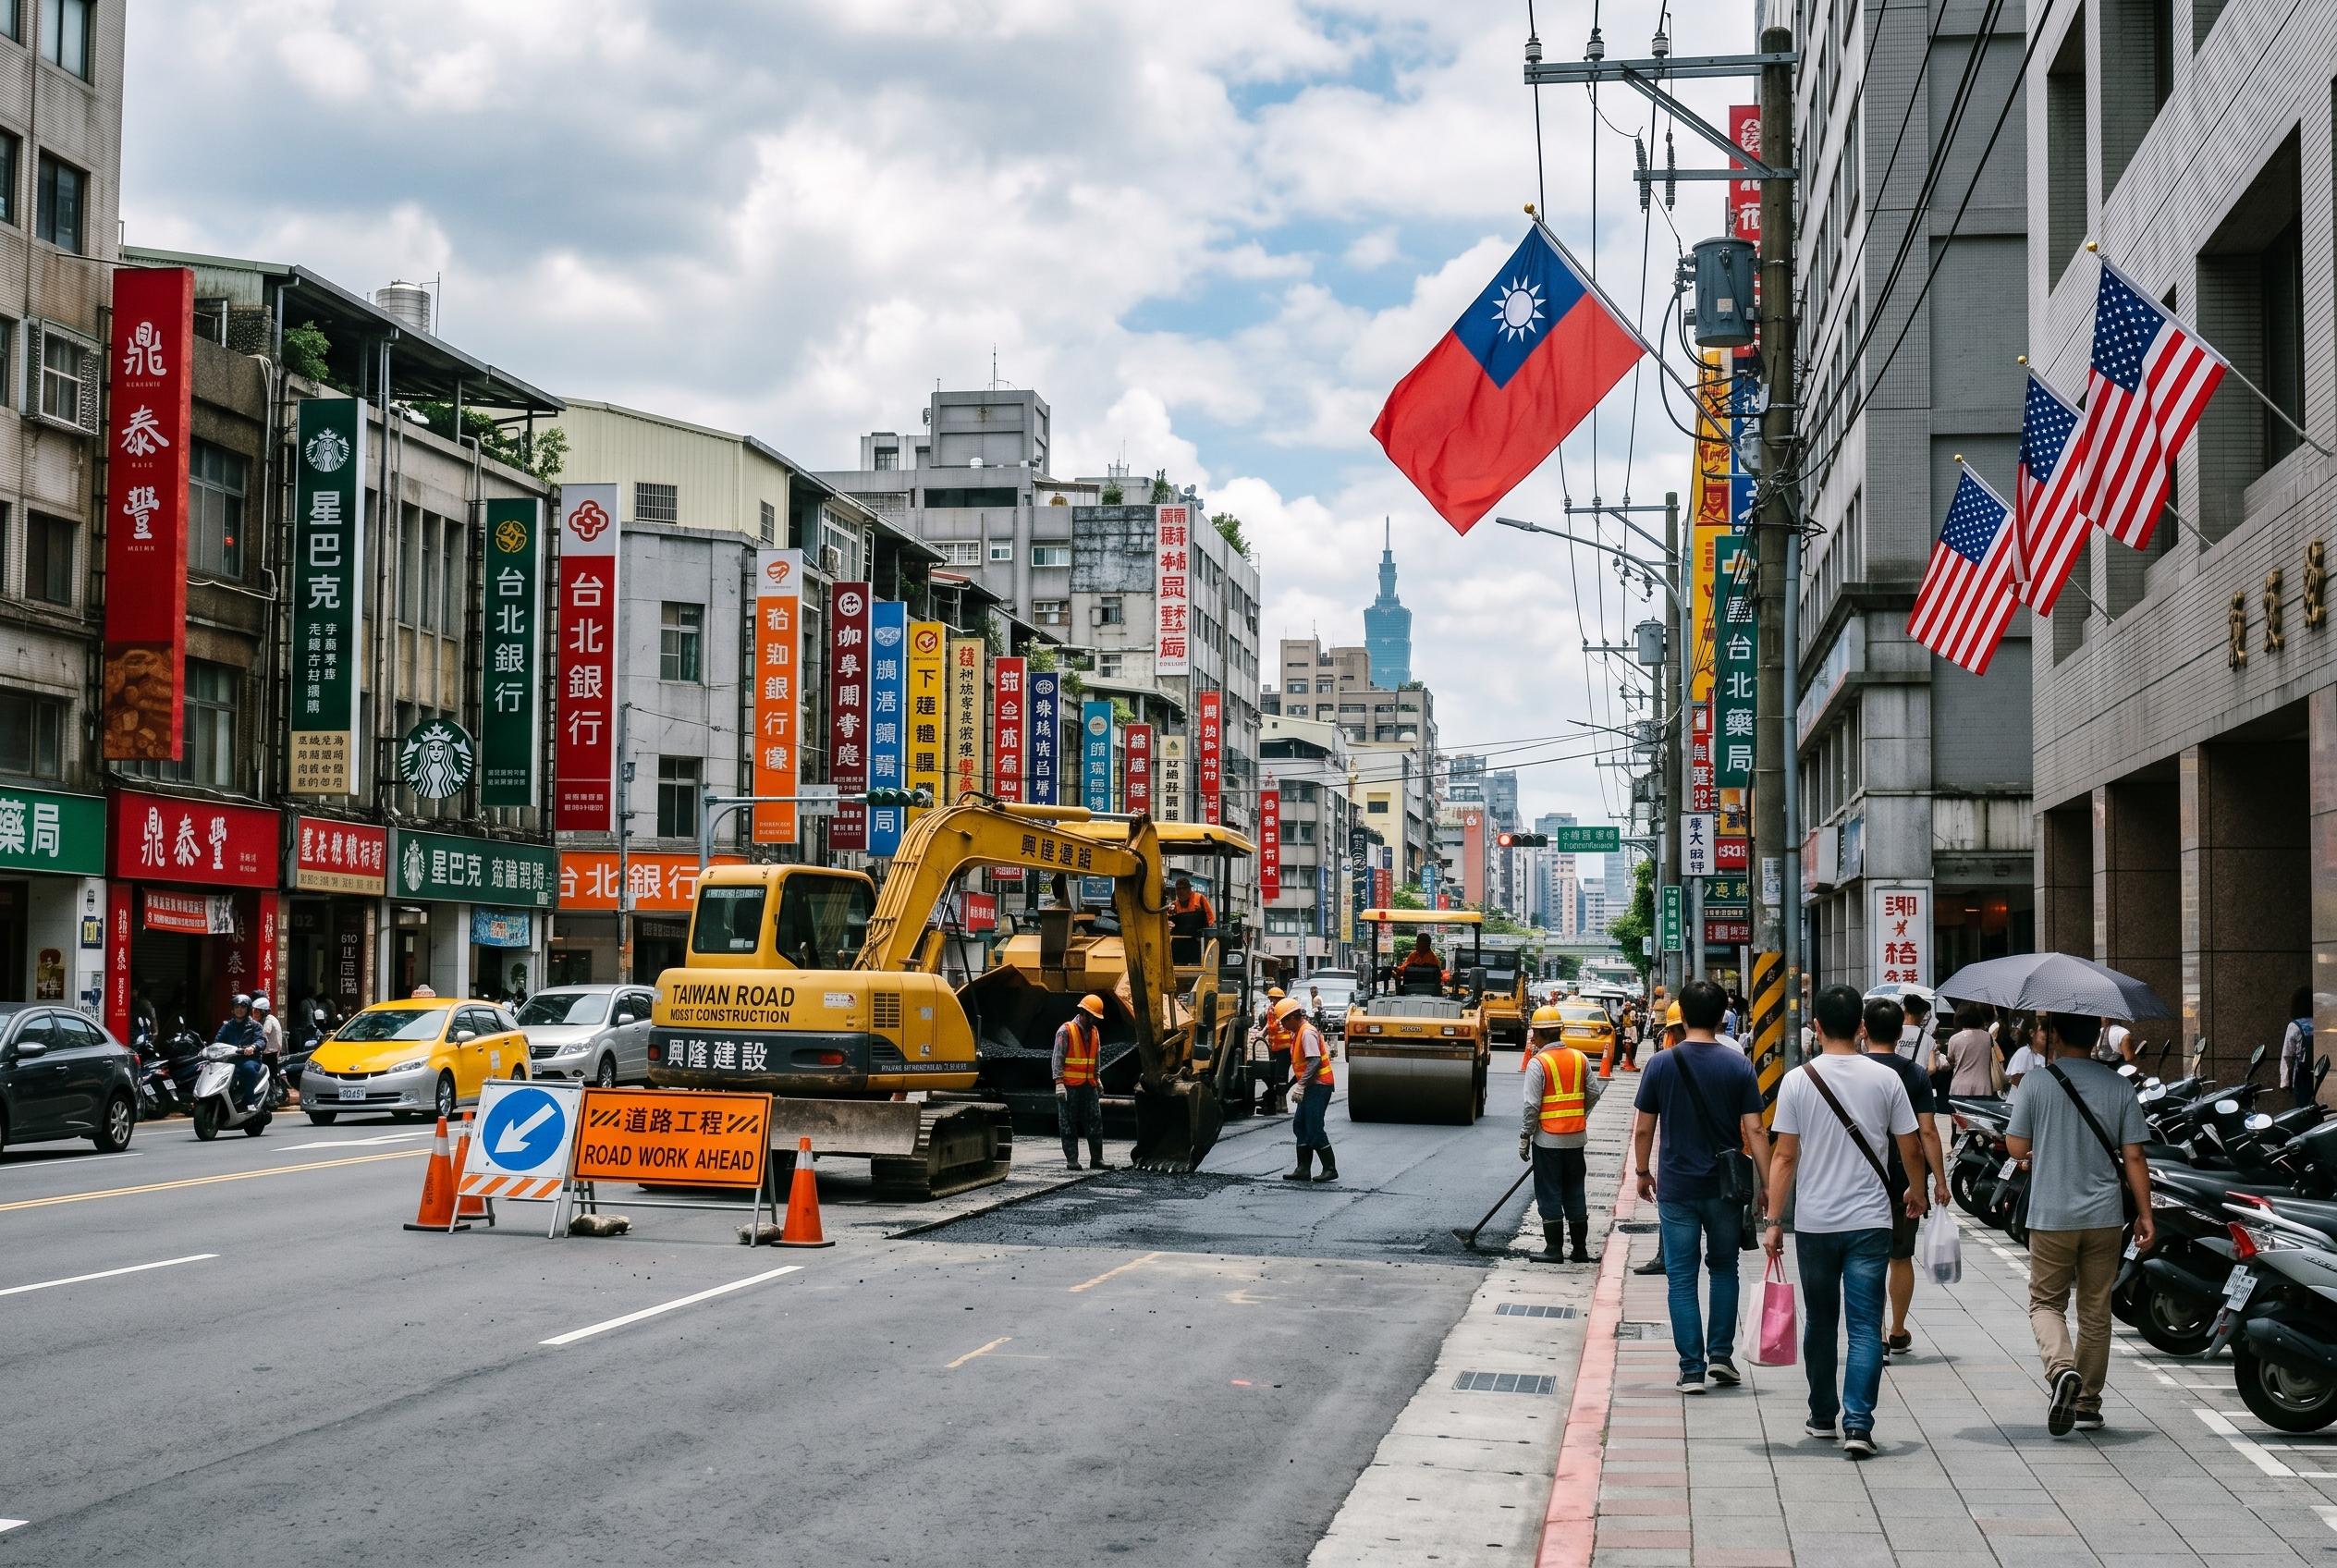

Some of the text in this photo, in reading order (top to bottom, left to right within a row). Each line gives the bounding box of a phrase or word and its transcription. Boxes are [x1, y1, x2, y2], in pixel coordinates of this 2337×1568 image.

[121, 321, 169, 540] 鼎泰豐
[307, 491, 341, 610] 星巴克
[495, 567, 525, 713] 台北銀行
[568, 572, 604, 745] 台北銀行
[0, 798, 60, 858] 藥局
[141, 806, 227, 870] 鼎泰豐
[432, 850, 482, 887] 星巴克
[560, 863, 700, 900] 台北銀行
[672, 984, 795, 1008] TAIWAN ROAD
[696, 1009, 789, 1023] CONSTRUCTION
[667, 1039, 768, 1072] 興隆建設
[624, 1106, 723, 1135] 道路工程
[583, 1144, 754, 1170] ROAD WORK AHEAD
